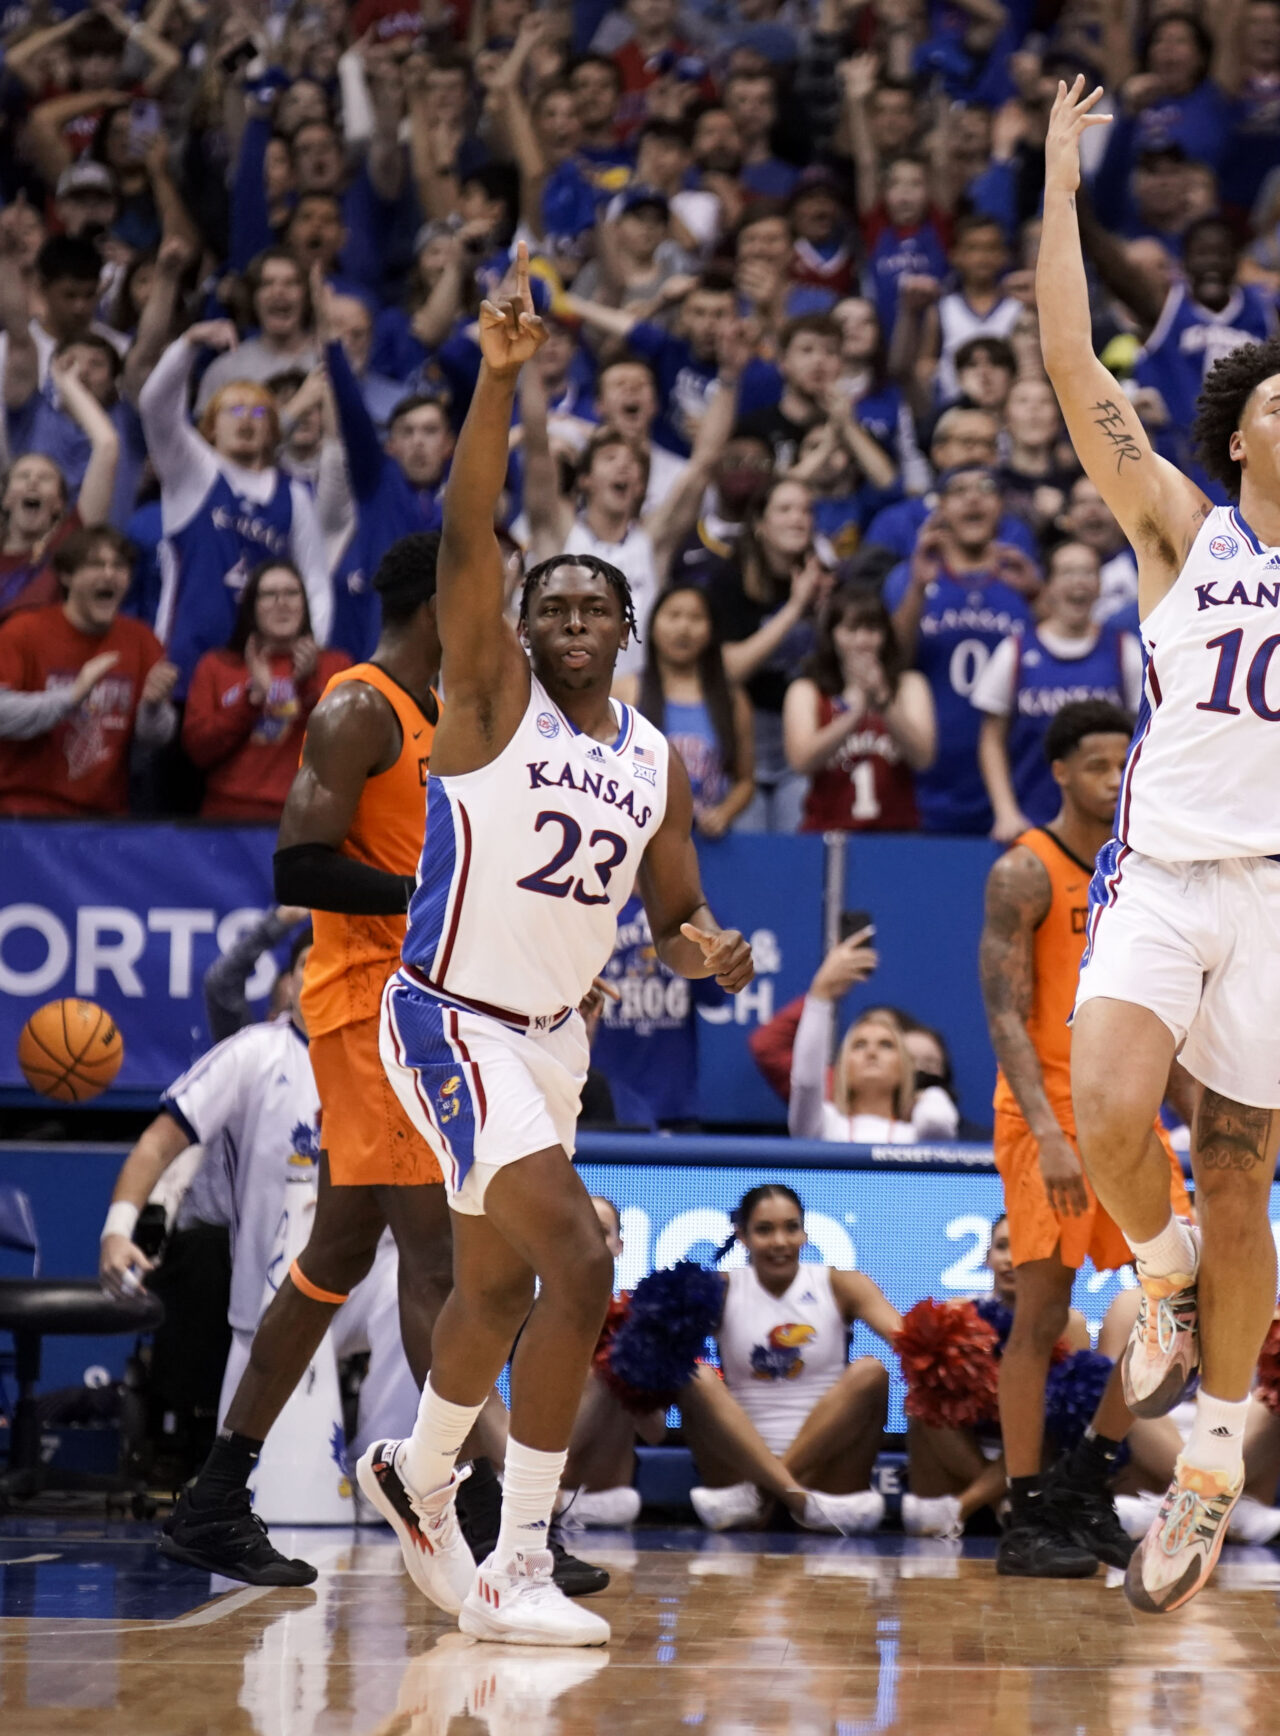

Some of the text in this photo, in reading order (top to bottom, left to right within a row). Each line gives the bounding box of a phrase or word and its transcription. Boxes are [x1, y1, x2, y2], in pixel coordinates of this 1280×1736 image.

[1088, 399, 1142, 476] FEAR
[950, 638, 991, 697] 0
[526, 761, 652, 828] KANSAS
[850, 760, 881, 820] 1
[516, 811, 628, 905] 23
